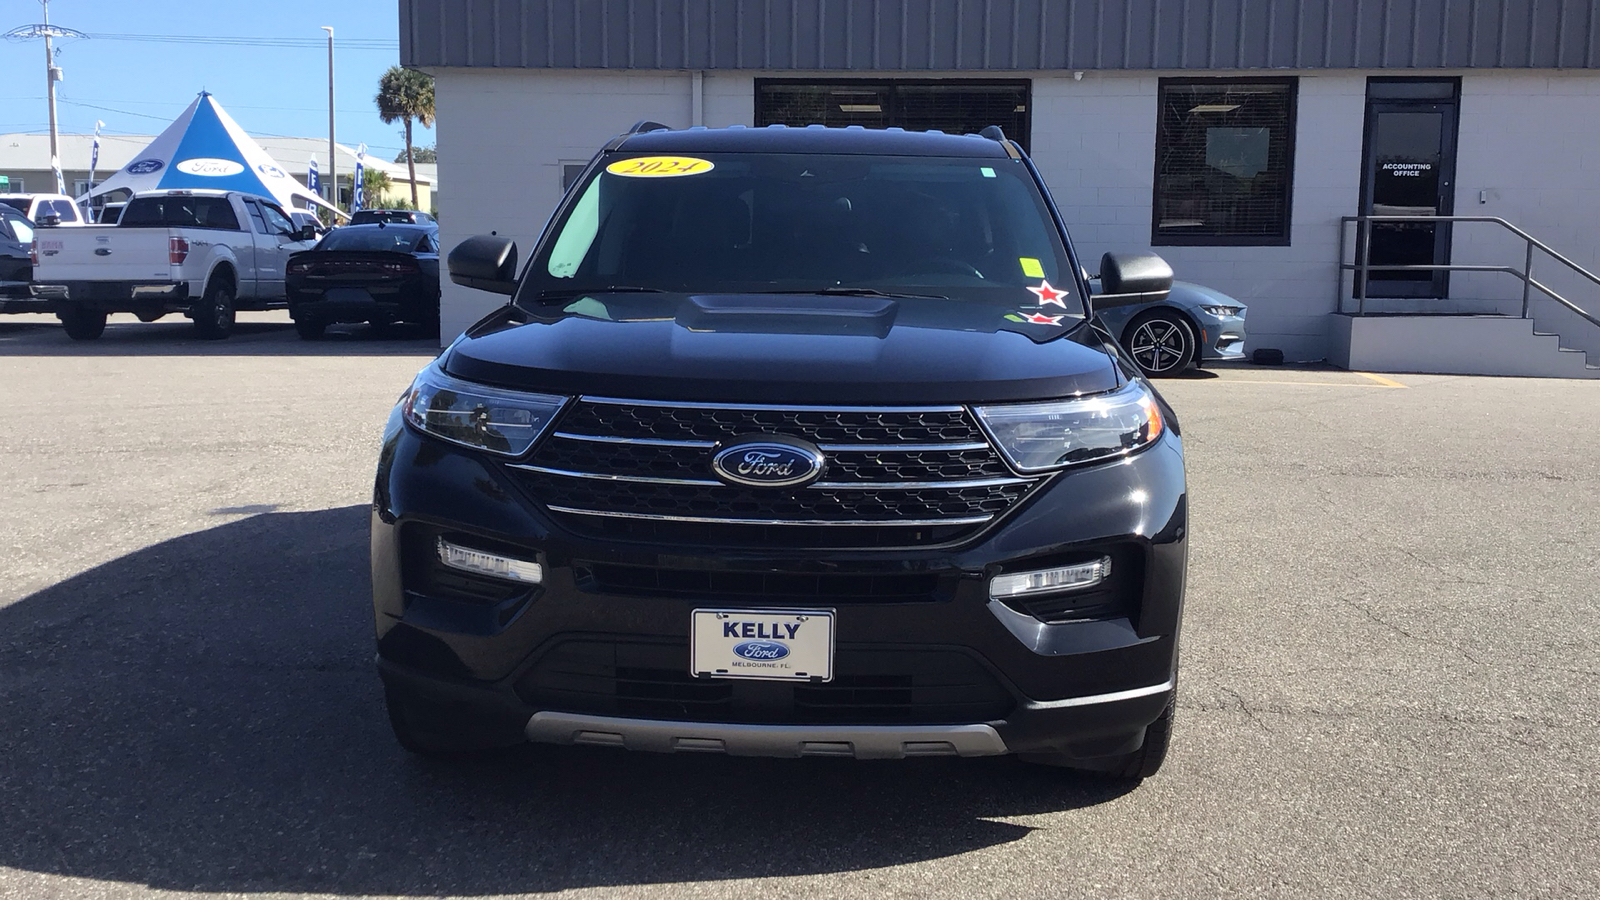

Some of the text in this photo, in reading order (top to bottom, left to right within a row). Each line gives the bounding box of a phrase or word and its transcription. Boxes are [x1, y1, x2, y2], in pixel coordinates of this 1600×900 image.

[191, 161, 230, 173] Ford
[620, 161, 702, 174] 2024
[738, 451, 795, 475] Ford
[723, 621, 801, 640] KELLY
[744, 643, 779, 659] Ford
